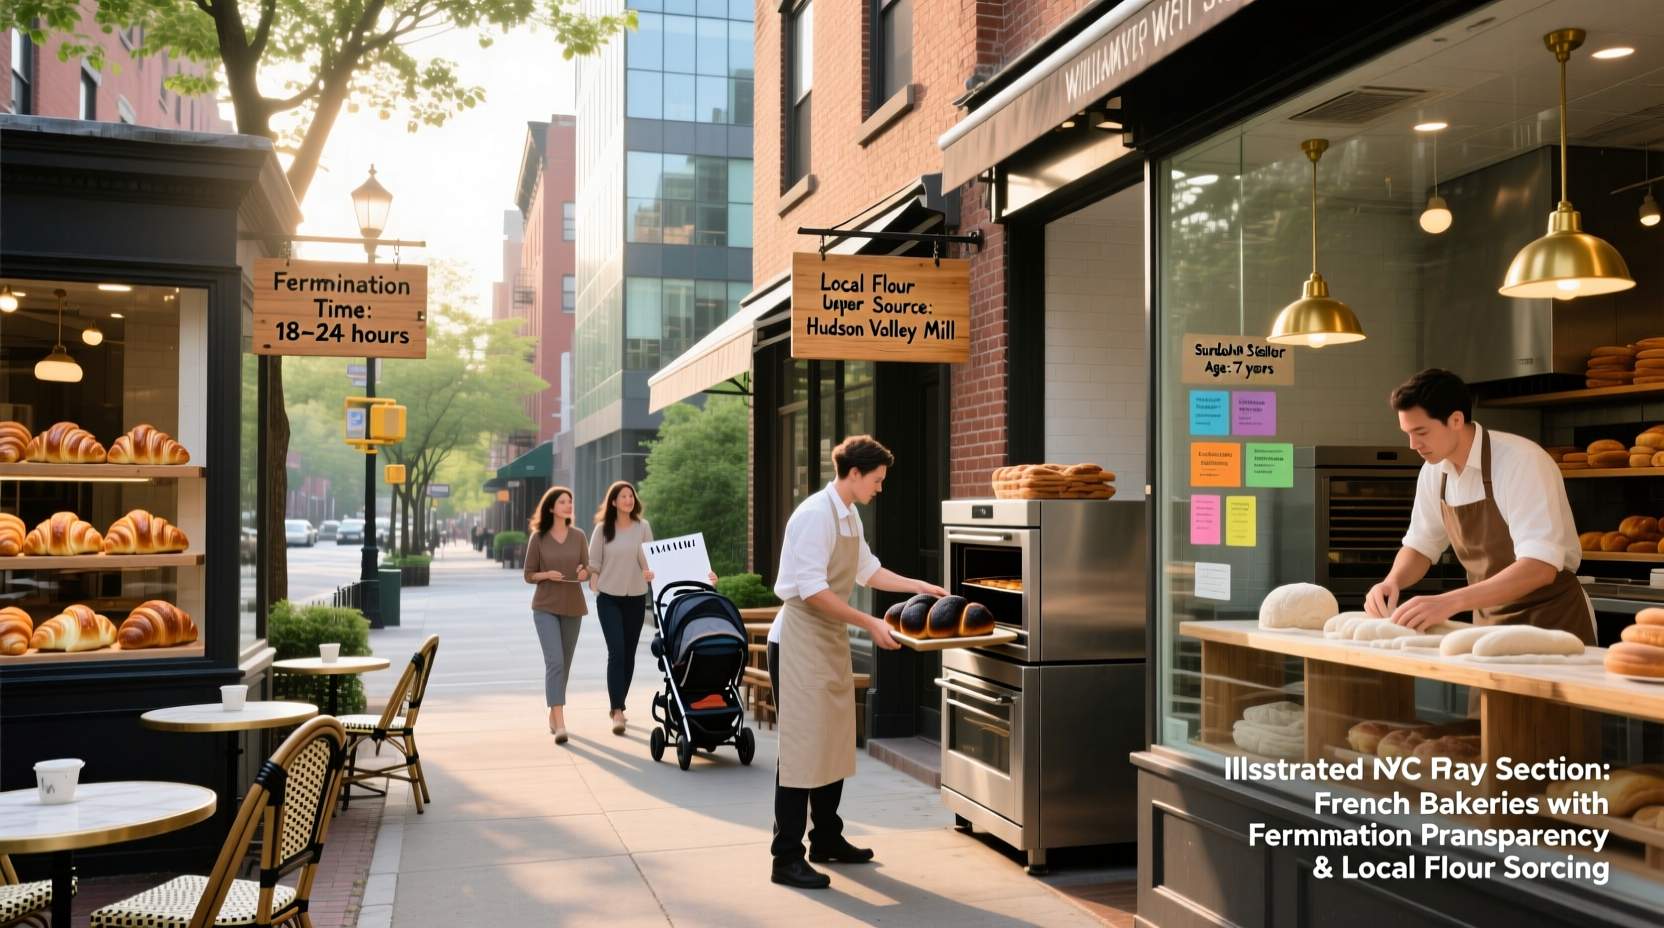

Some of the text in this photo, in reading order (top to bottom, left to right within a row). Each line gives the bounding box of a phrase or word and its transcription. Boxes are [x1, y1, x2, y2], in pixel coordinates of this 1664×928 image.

[820, 272, 916, 294] Local Flour
[313, 298, 372, 319] Time:
[872, 296, 933, 315] Source:
[351, 323, 410, 344] hours
[806, 316, 864, 336] Hudson
[923, 319, 955, 340] Mill
[1205, 360, 1232, 377] Age:
[1232, 360, 1243, 374] 7
